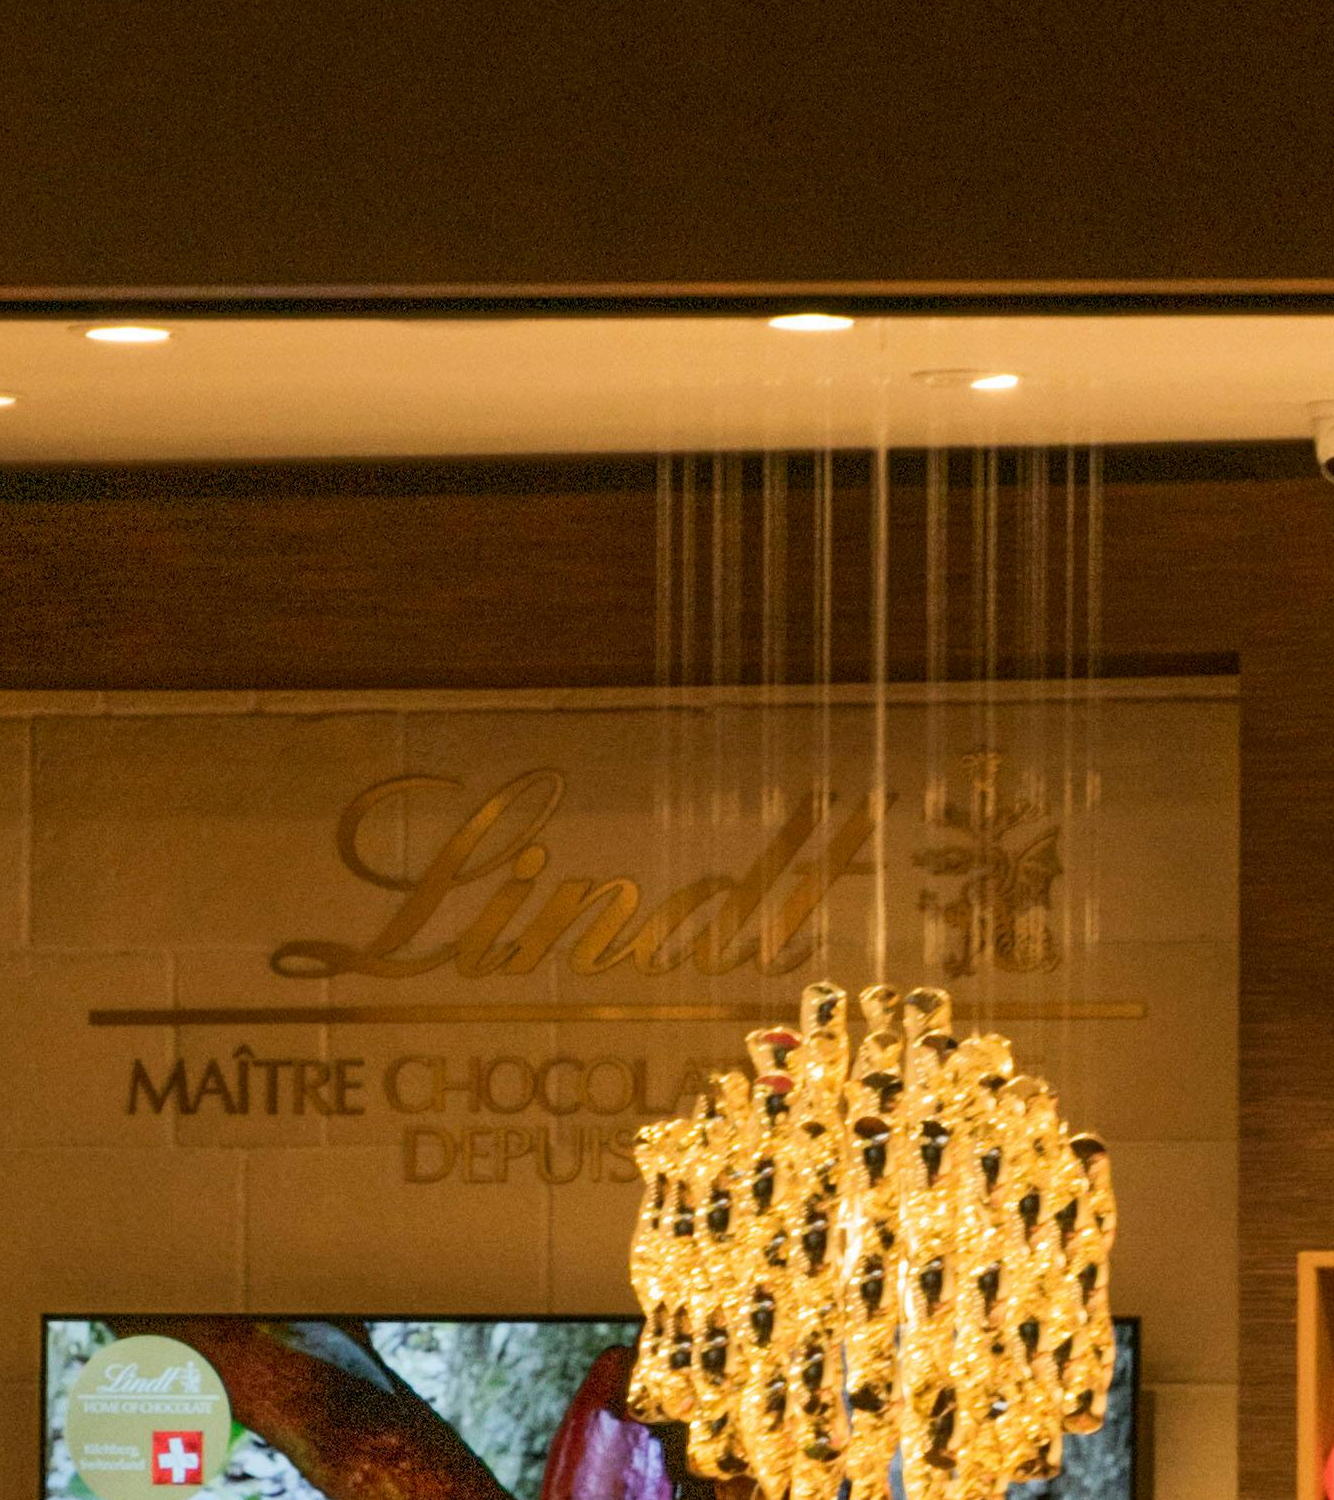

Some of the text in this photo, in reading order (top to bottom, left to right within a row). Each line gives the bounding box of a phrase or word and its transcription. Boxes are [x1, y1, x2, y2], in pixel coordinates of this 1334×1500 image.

[269, 766, 898, 980] Lindt
[126, 1043, 367, 1116] MAÎTRE
[402, 1124, 642, 1185] DEPUIS
[95, 1363, 182, 1394] Lindt
